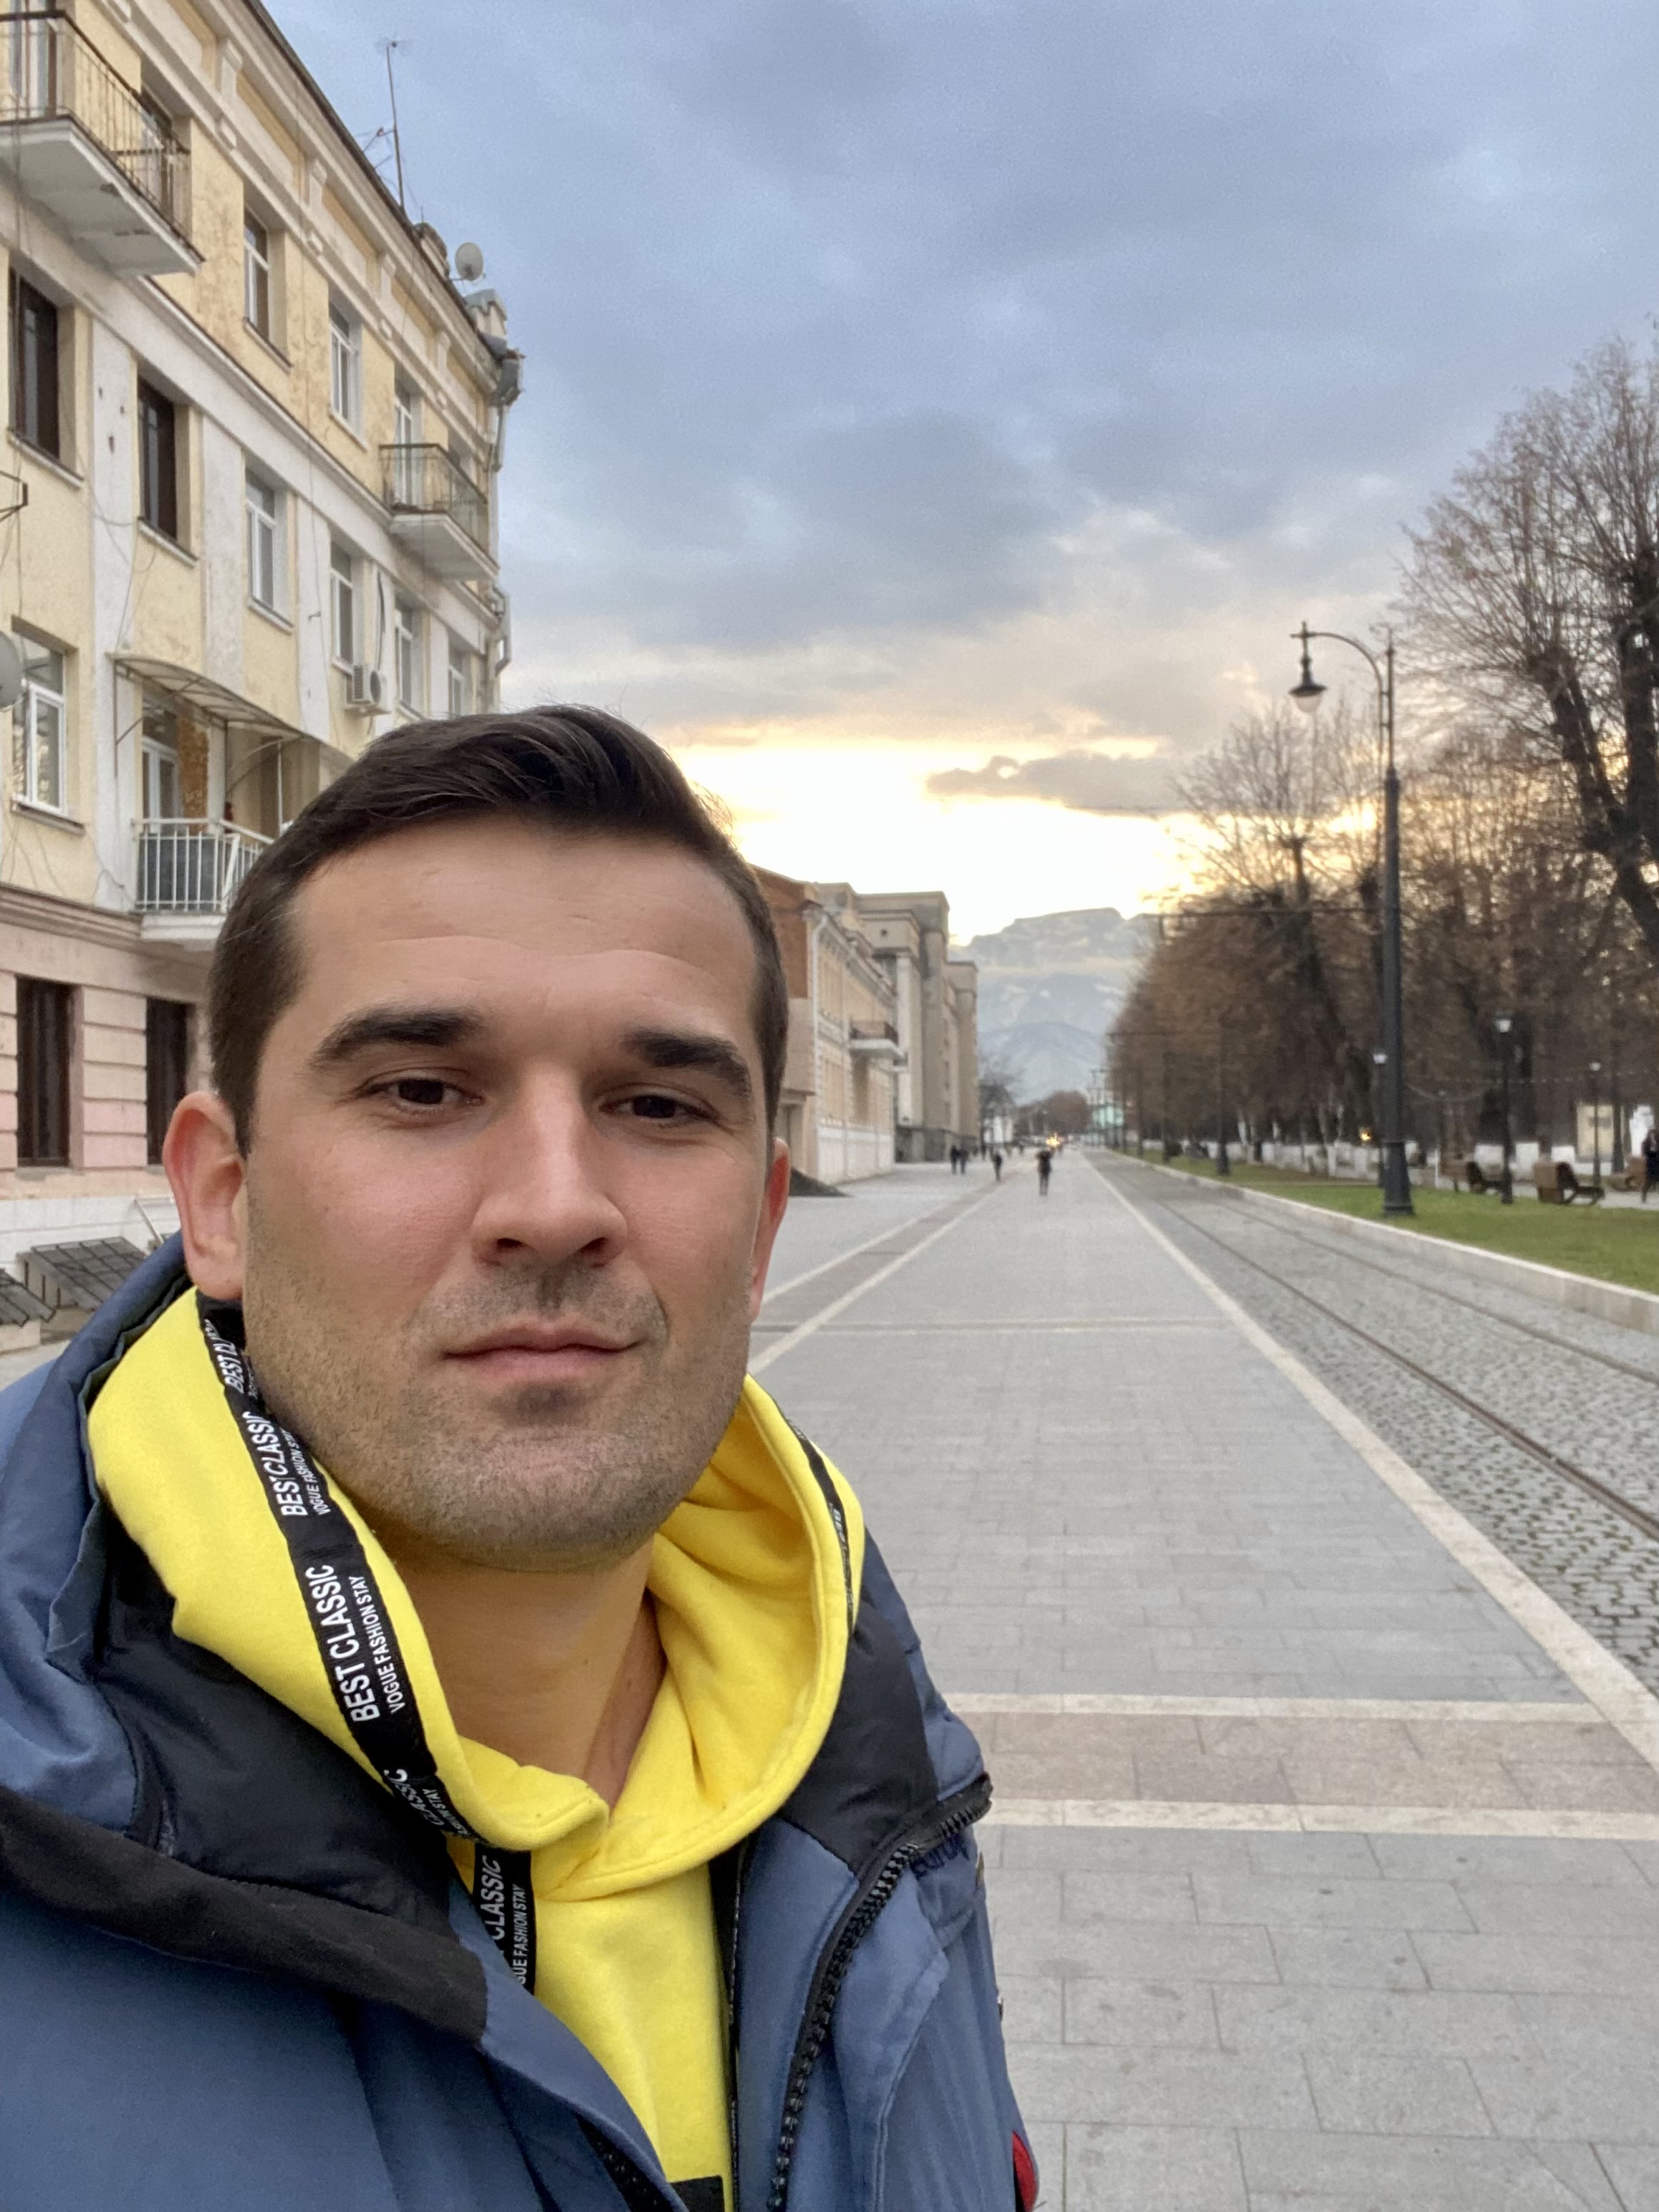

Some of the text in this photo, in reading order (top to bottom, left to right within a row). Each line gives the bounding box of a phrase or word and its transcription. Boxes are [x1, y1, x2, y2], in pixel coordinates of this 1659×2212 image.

[217, 1355, 244, 1393] BEST
[290, 1448, 318, 1483] FASHION
[269, 1476, 308, 1516] BEST
[307, 1484, 331, 1515] VOGUE
[305, 1564, 380, 1722] BEST CLASSIC
[349, 1576, 405, 1713] VOGUE FASHION STAY
[512, 1883, 529, 1984] GUE FASHION STAY
